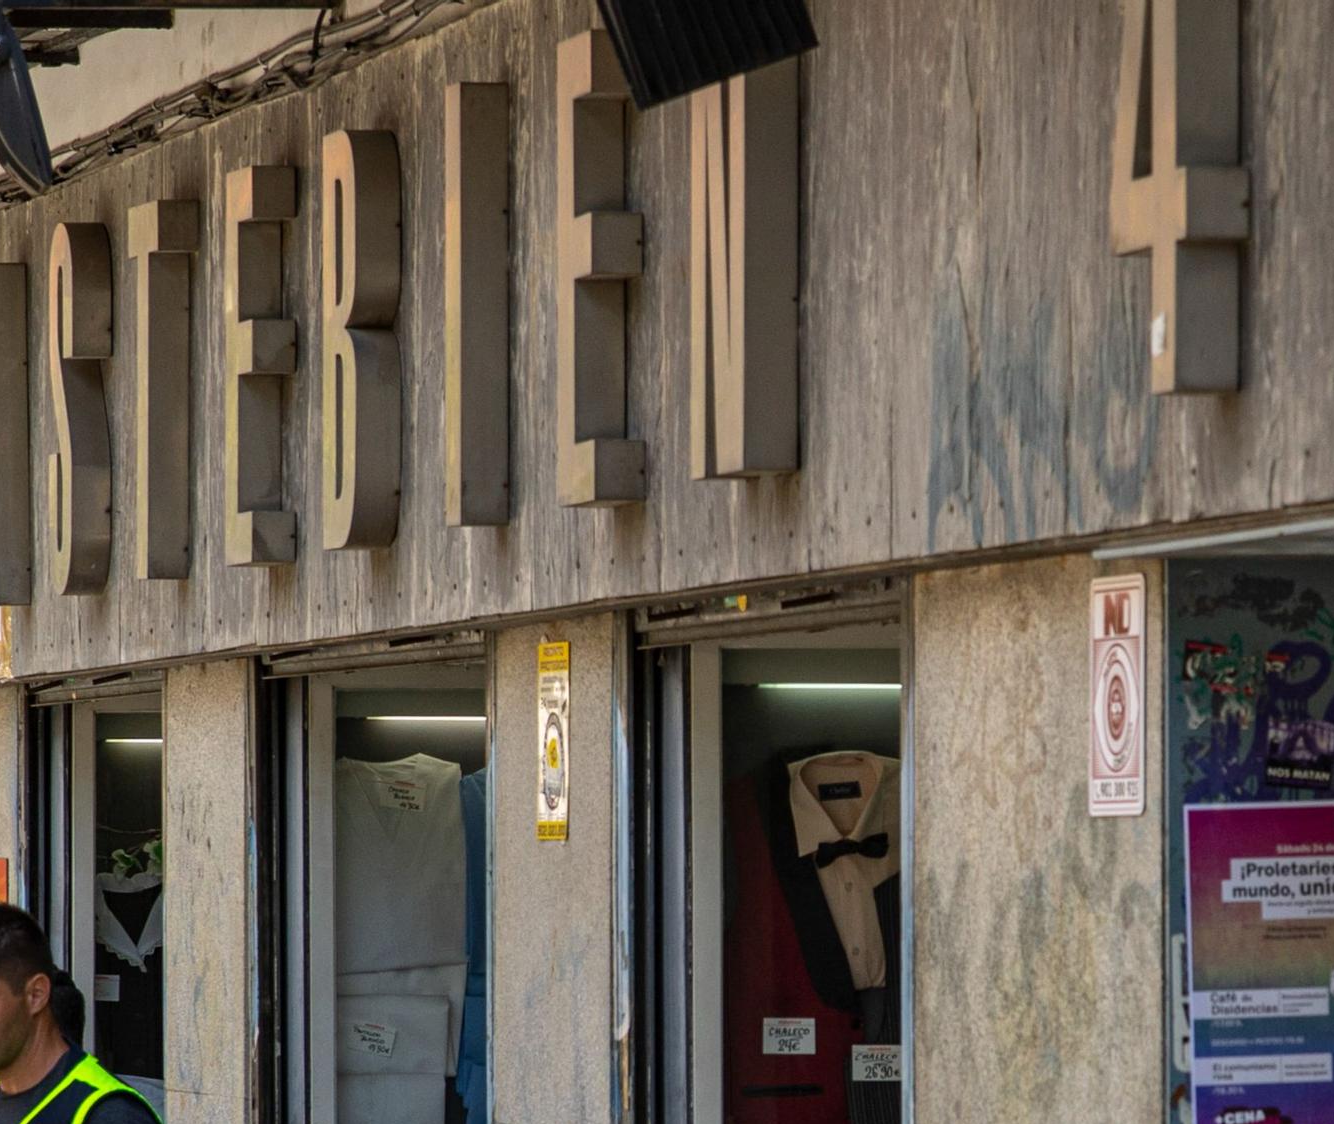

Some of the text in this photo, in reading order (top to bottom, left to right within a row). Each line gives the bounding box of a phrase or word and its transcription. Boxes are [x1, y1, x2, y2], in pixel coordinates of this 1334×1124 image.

[1232, 883, 1296, 899] mundo,
[1210, 991, 1237, 1003] Café
[1212, 1003, 1278, 1015] Disidencias
